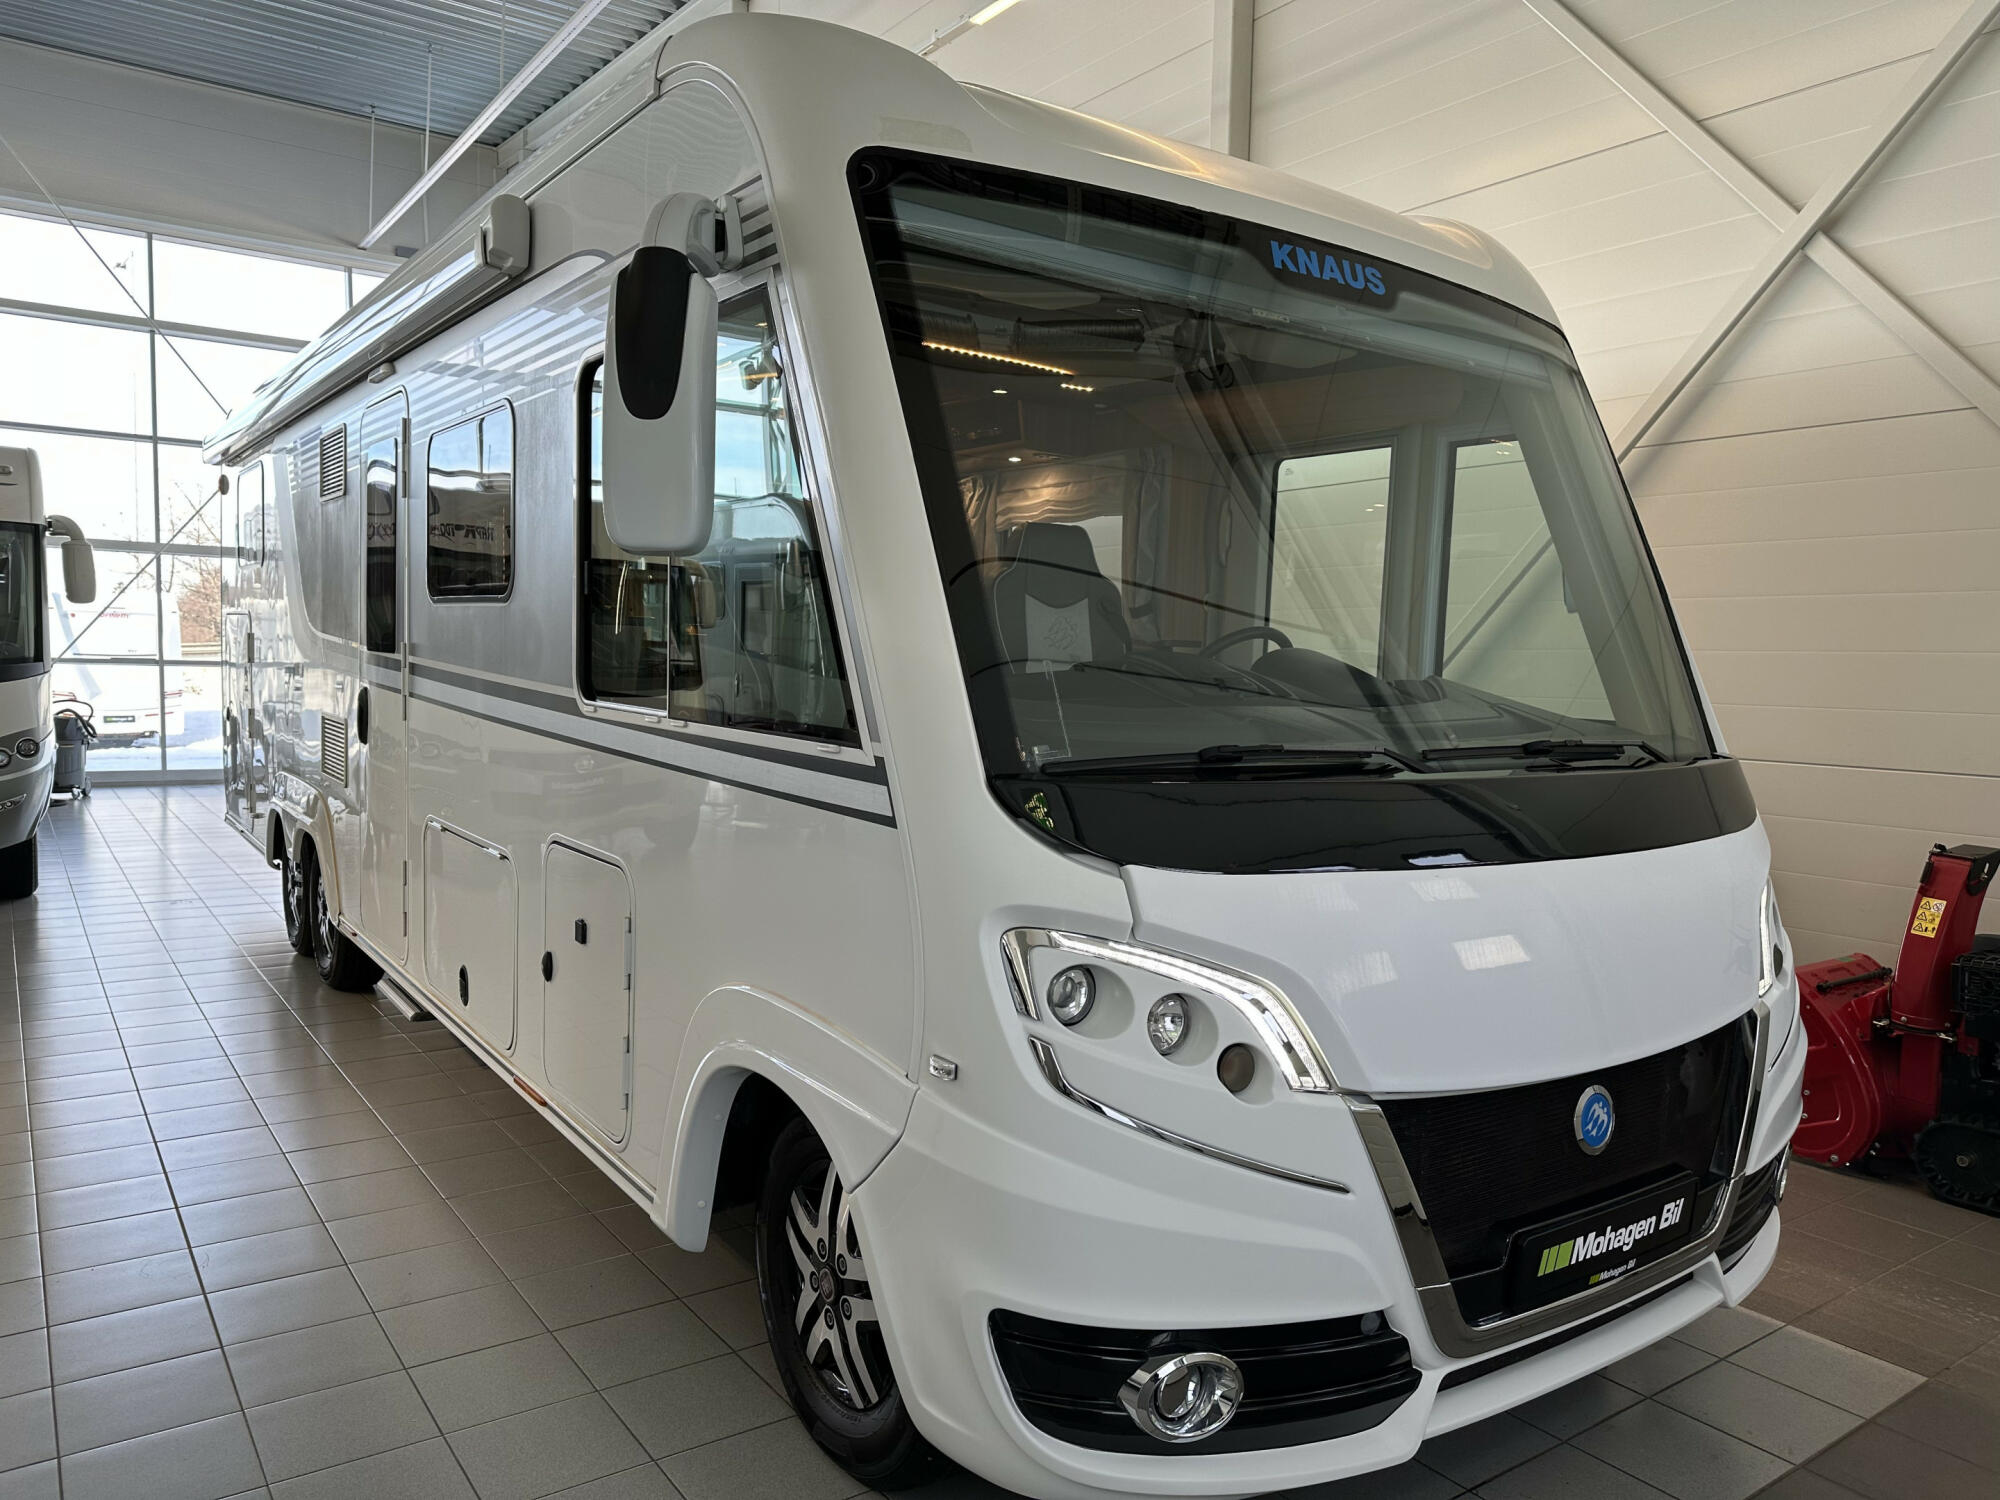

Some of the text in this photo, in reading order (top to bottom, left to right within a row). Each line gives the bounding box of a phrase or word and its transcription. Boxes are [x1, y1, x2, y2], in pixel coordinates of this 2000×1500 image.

[1270, 239, 1386, 295] KNAUS
[1570, 1198, 1685, 1265] Mohagen Bil
[1599, 1258, 1637, 1281] Mohagen Bil
